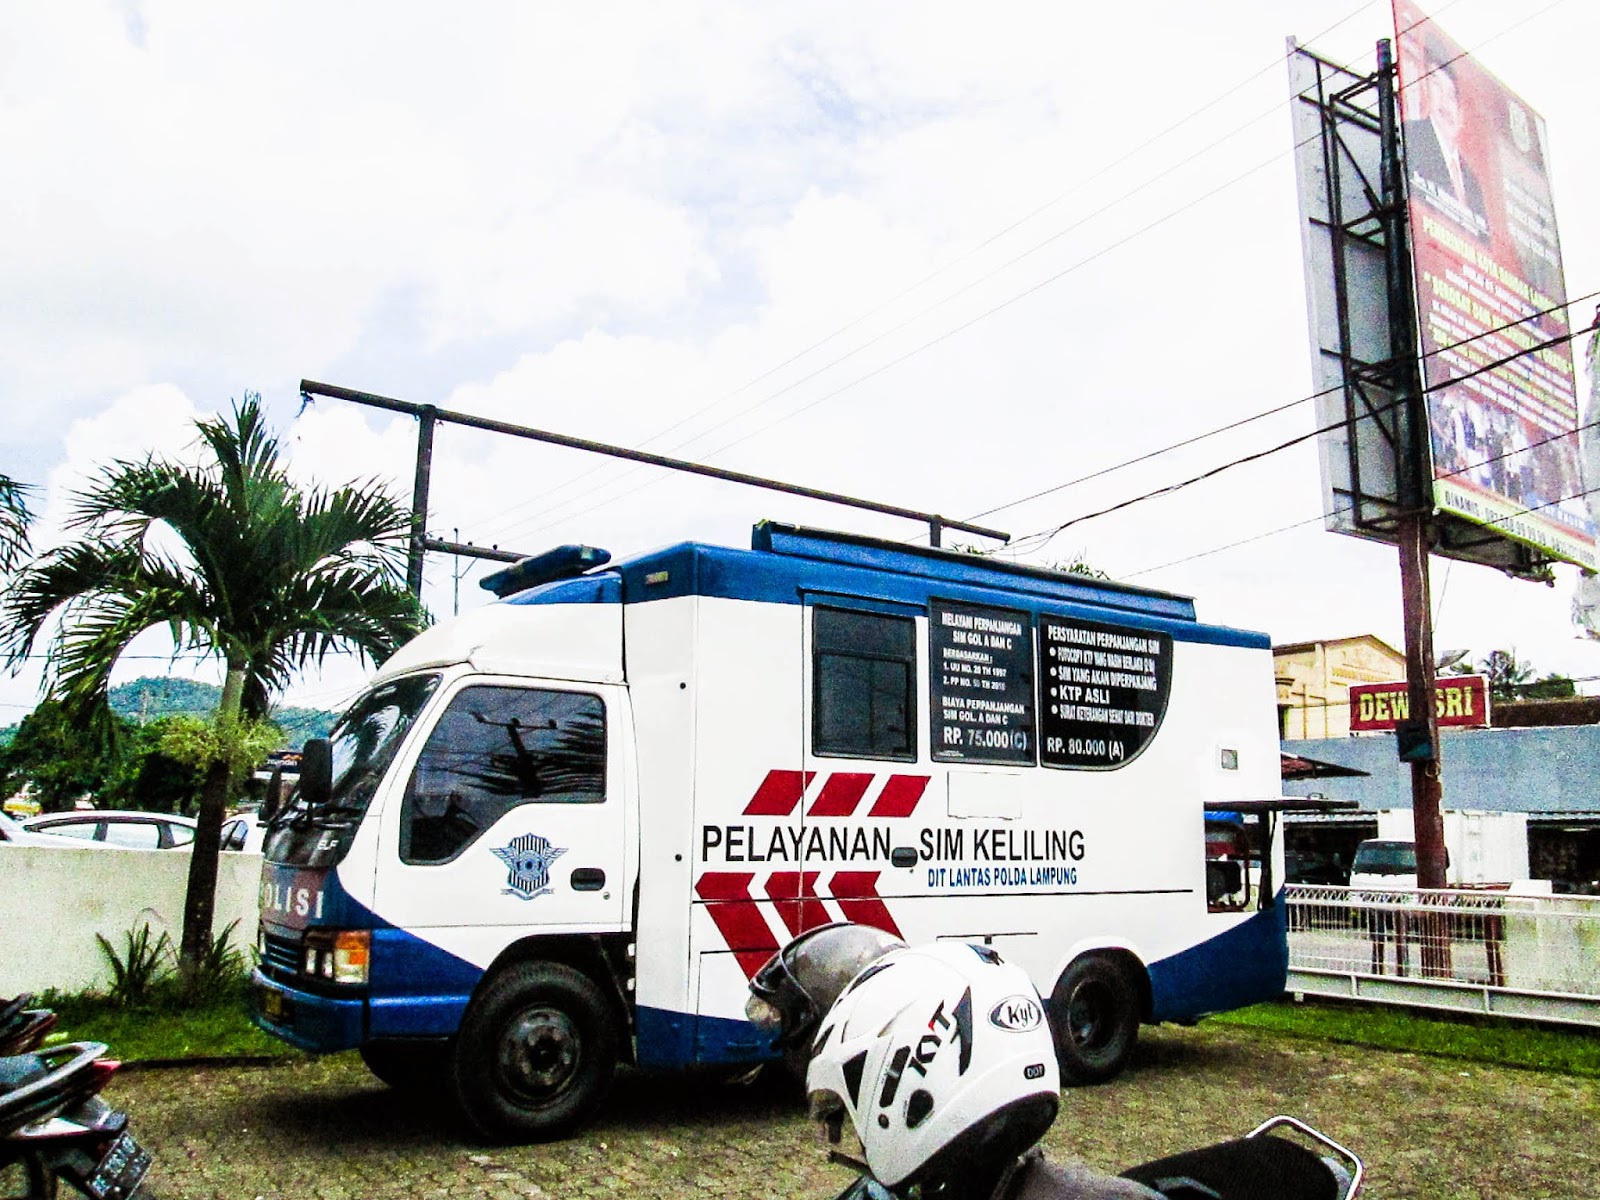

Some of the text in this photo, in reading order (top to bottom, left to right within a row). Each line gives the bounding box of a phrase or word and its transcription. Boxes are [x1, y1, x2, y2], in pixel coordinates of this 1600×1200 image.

[953, 630, 1012, 650] SIM GOL A DAN C
[1047, 624, 1096, 646] PERSYARATAN
[1072, 667, 1090, 683] YANG
[1091, 669, 1110, 686] AKAN
[942, 695, 1025, 714] BIAYA PERPANJANGAN
[1060, 684, 1110, 704] KTP ASLI
[1359, 690, 1409, 722] DEW
[943, 709, 957, 720] SIM
[978, 712, 984, 723] A
[985, 713, 1001, 724] DAN
[1002, 715, 1008, 725] C
[943, 726, 963, 745] RP.
[1047, 736, 1124, 760] RP. 80.000 (A)
[702, 825, 1085, 862] PELAYANAN SIM KELILING
[928, 866, 1077, 888] DIT LANTAS POLDA LAMPUNG
[261, 882, 324, 919] OLISI
